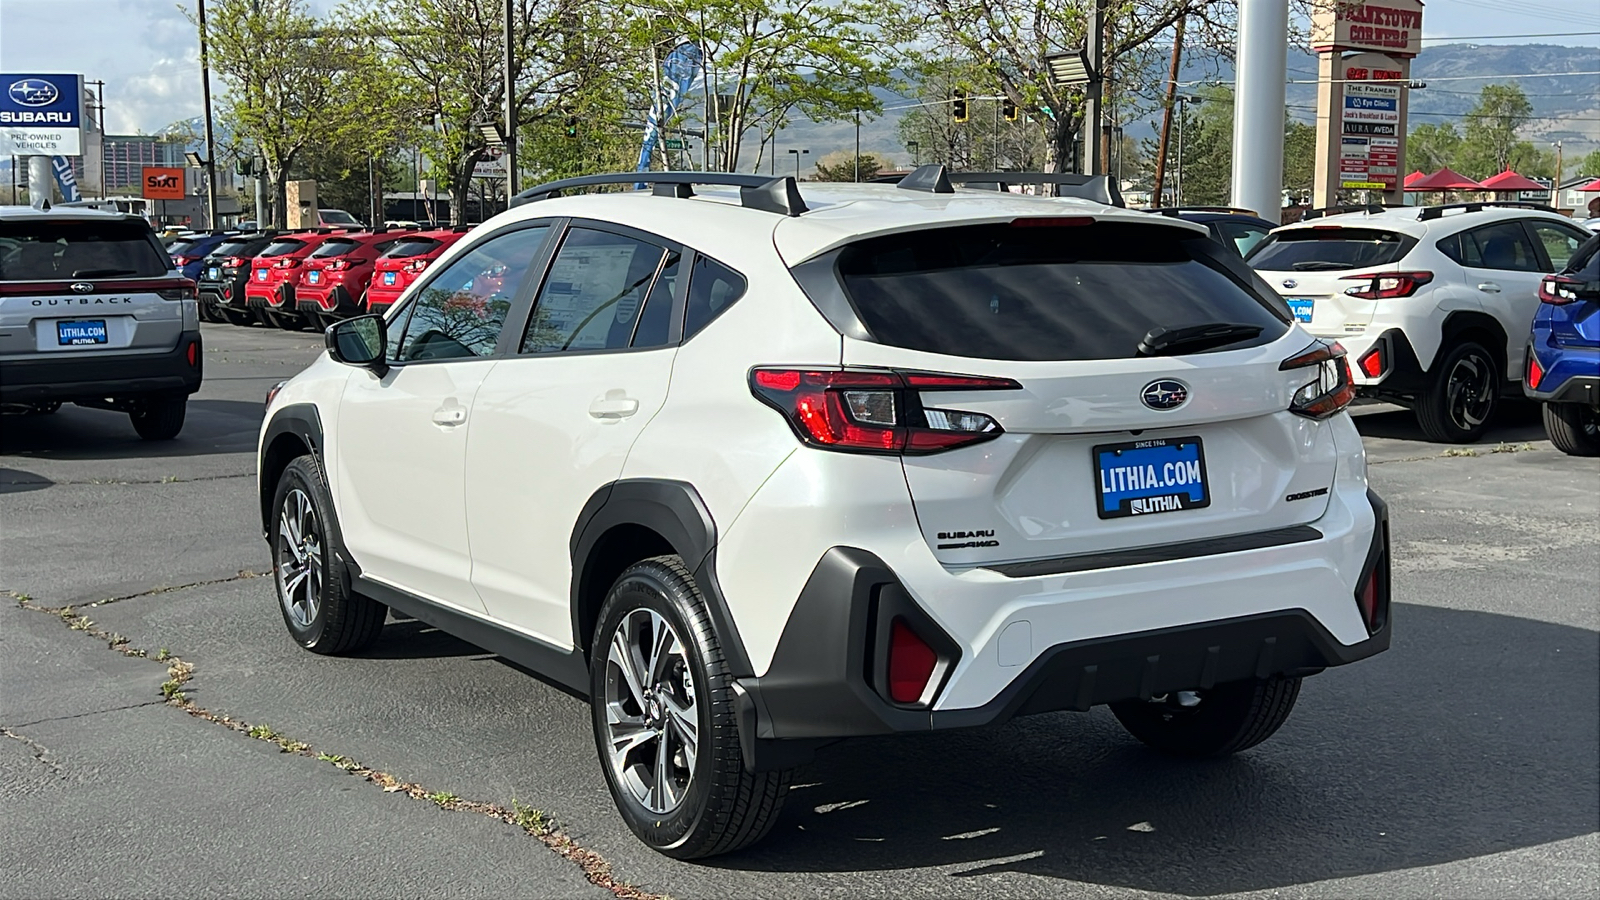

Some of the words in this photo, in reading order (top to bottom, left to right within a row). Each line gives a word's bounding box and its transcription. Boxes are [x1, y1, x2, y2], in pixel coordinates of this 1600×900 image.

[1350, 25, 1408, 48] CORNERS
[1347, 84, 1362, 92] THE
[1365, 86, 1397, 94] FRAMERY
[1363, 99, 1372, 107] Eye
[0, 112, 71, 122] SUBARU
[1345, 124, 1369, 133] AURA
[1373, 126, 1394, 134] AVEDA
[31, 297, 132, 306] OUTBACK
[60, 327, 105, 338] LITHIA.COM
[1101, 460, 1201, 493] LITHIA.COM
[1143, 495, 1182, 513] LITHIA
[937, 530, 995, 539] SUBARU
